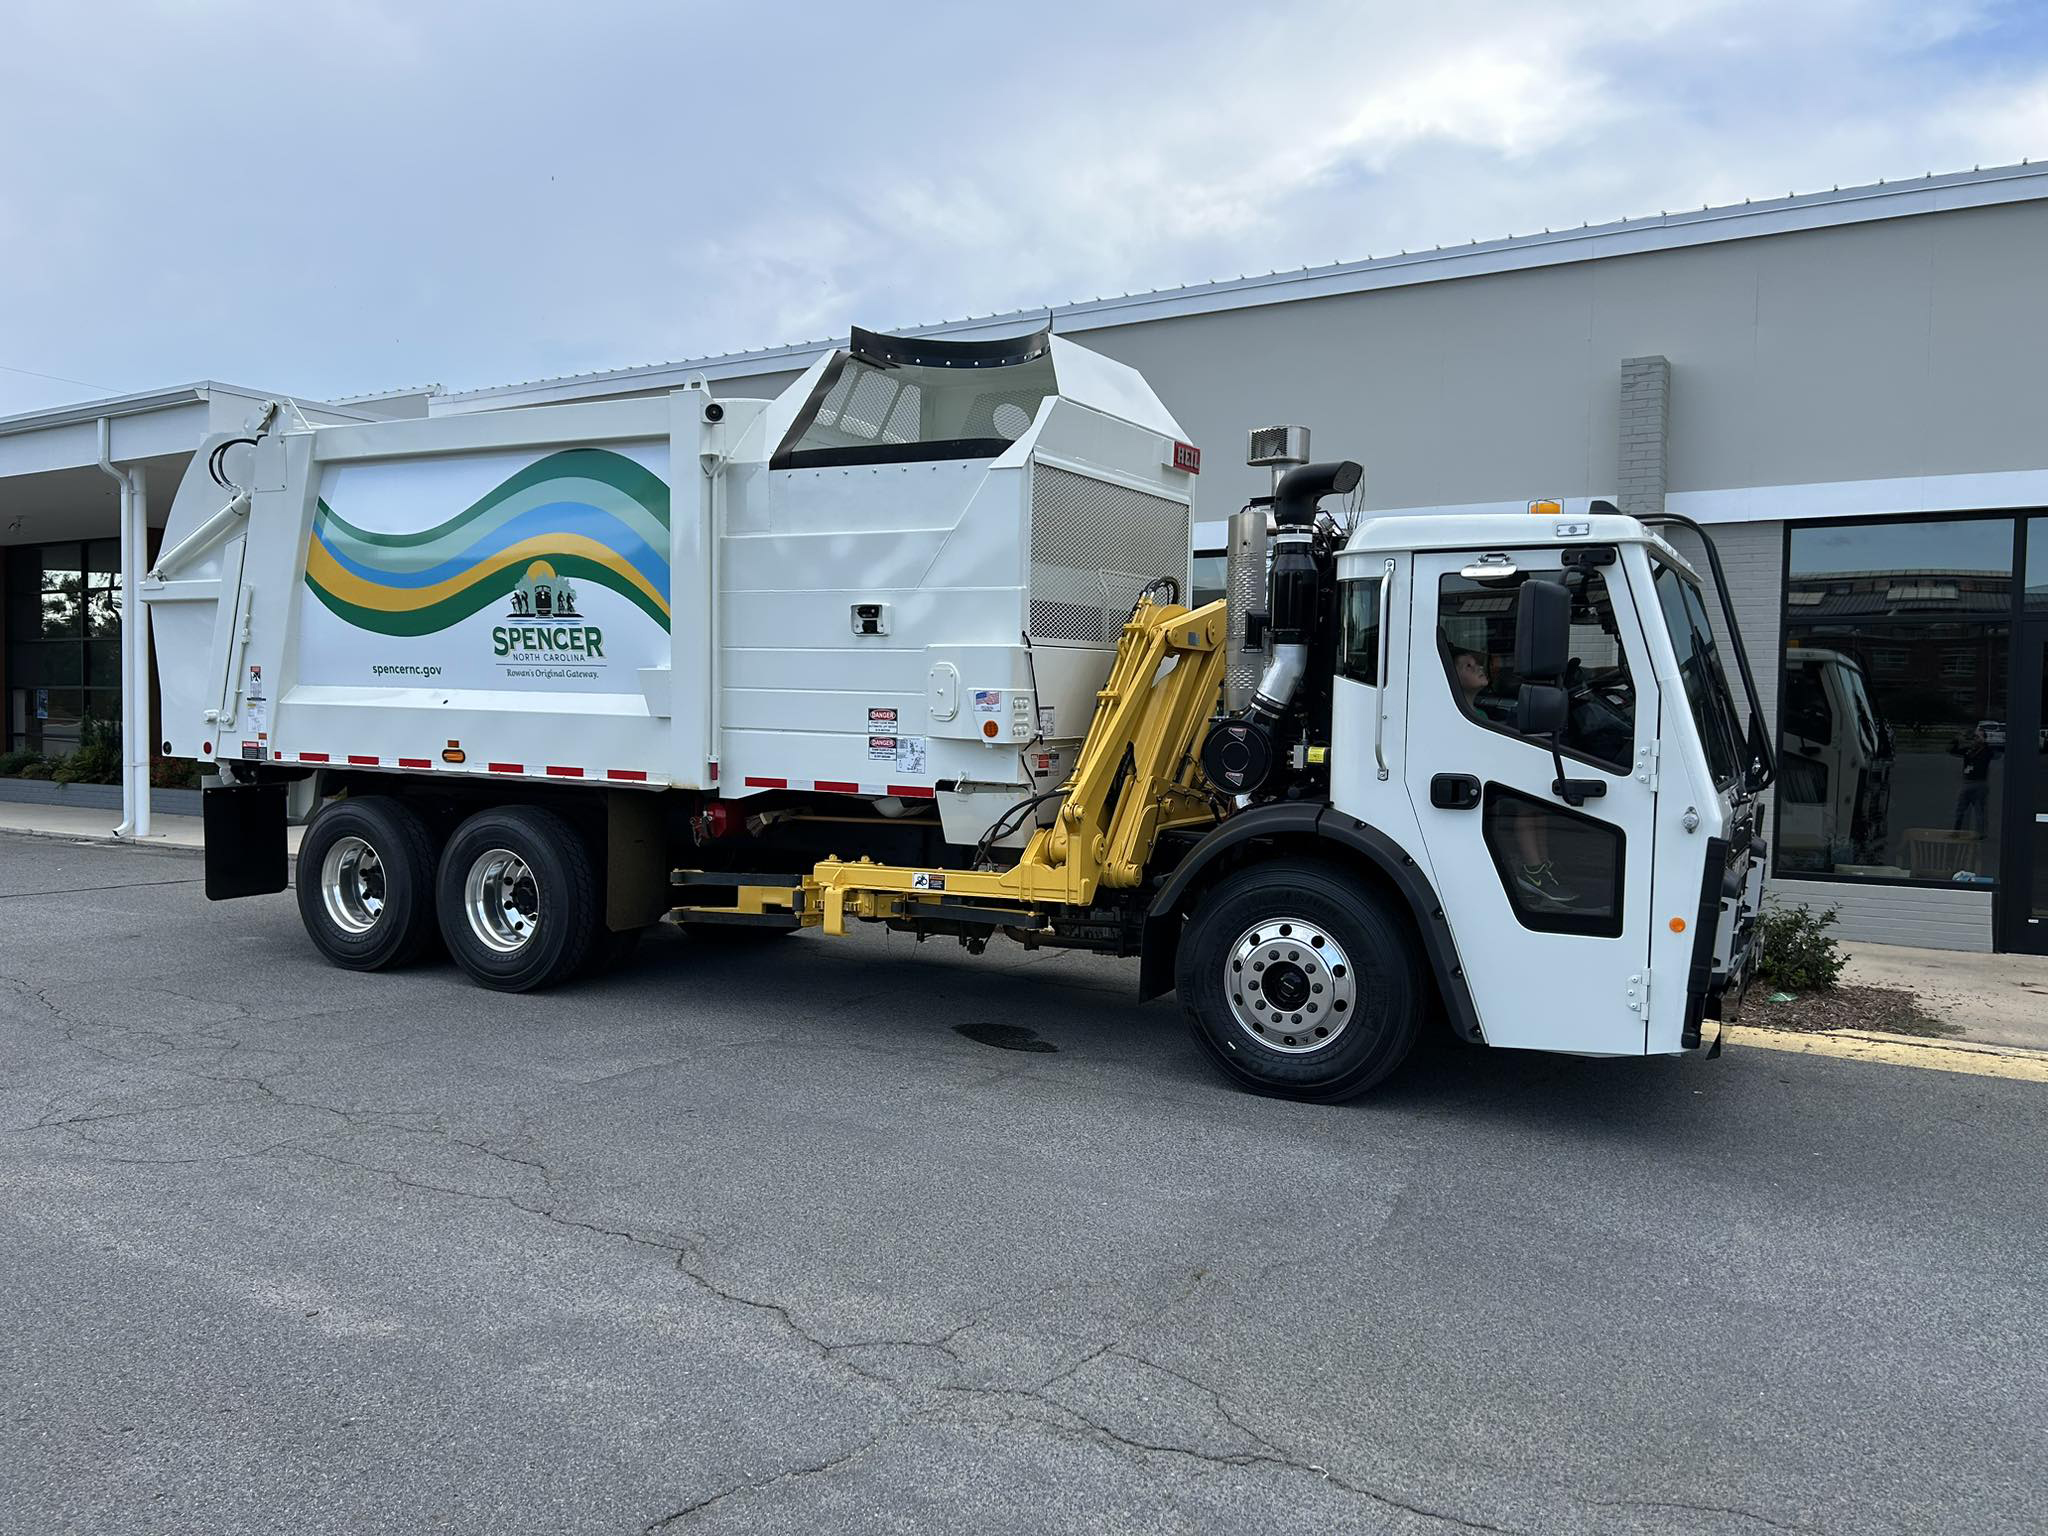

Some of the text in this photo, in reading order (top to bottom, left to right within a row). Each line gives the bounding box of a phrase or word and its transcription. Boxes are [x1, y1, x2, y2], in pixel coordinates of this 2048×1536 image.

[1178, 447, 1200, 469] HEIL
[492, 626, 604, 657] SPENCER
[513, 653, 586, 662] NORTH CAROLINA
[372, 665, 442, 678] spencernc.gov
[506, 668, 600, 680] Rowan's Original Gateway.
[870, 711, 895, 719] DANGER
[870, 739, 895, 747] DANGER
